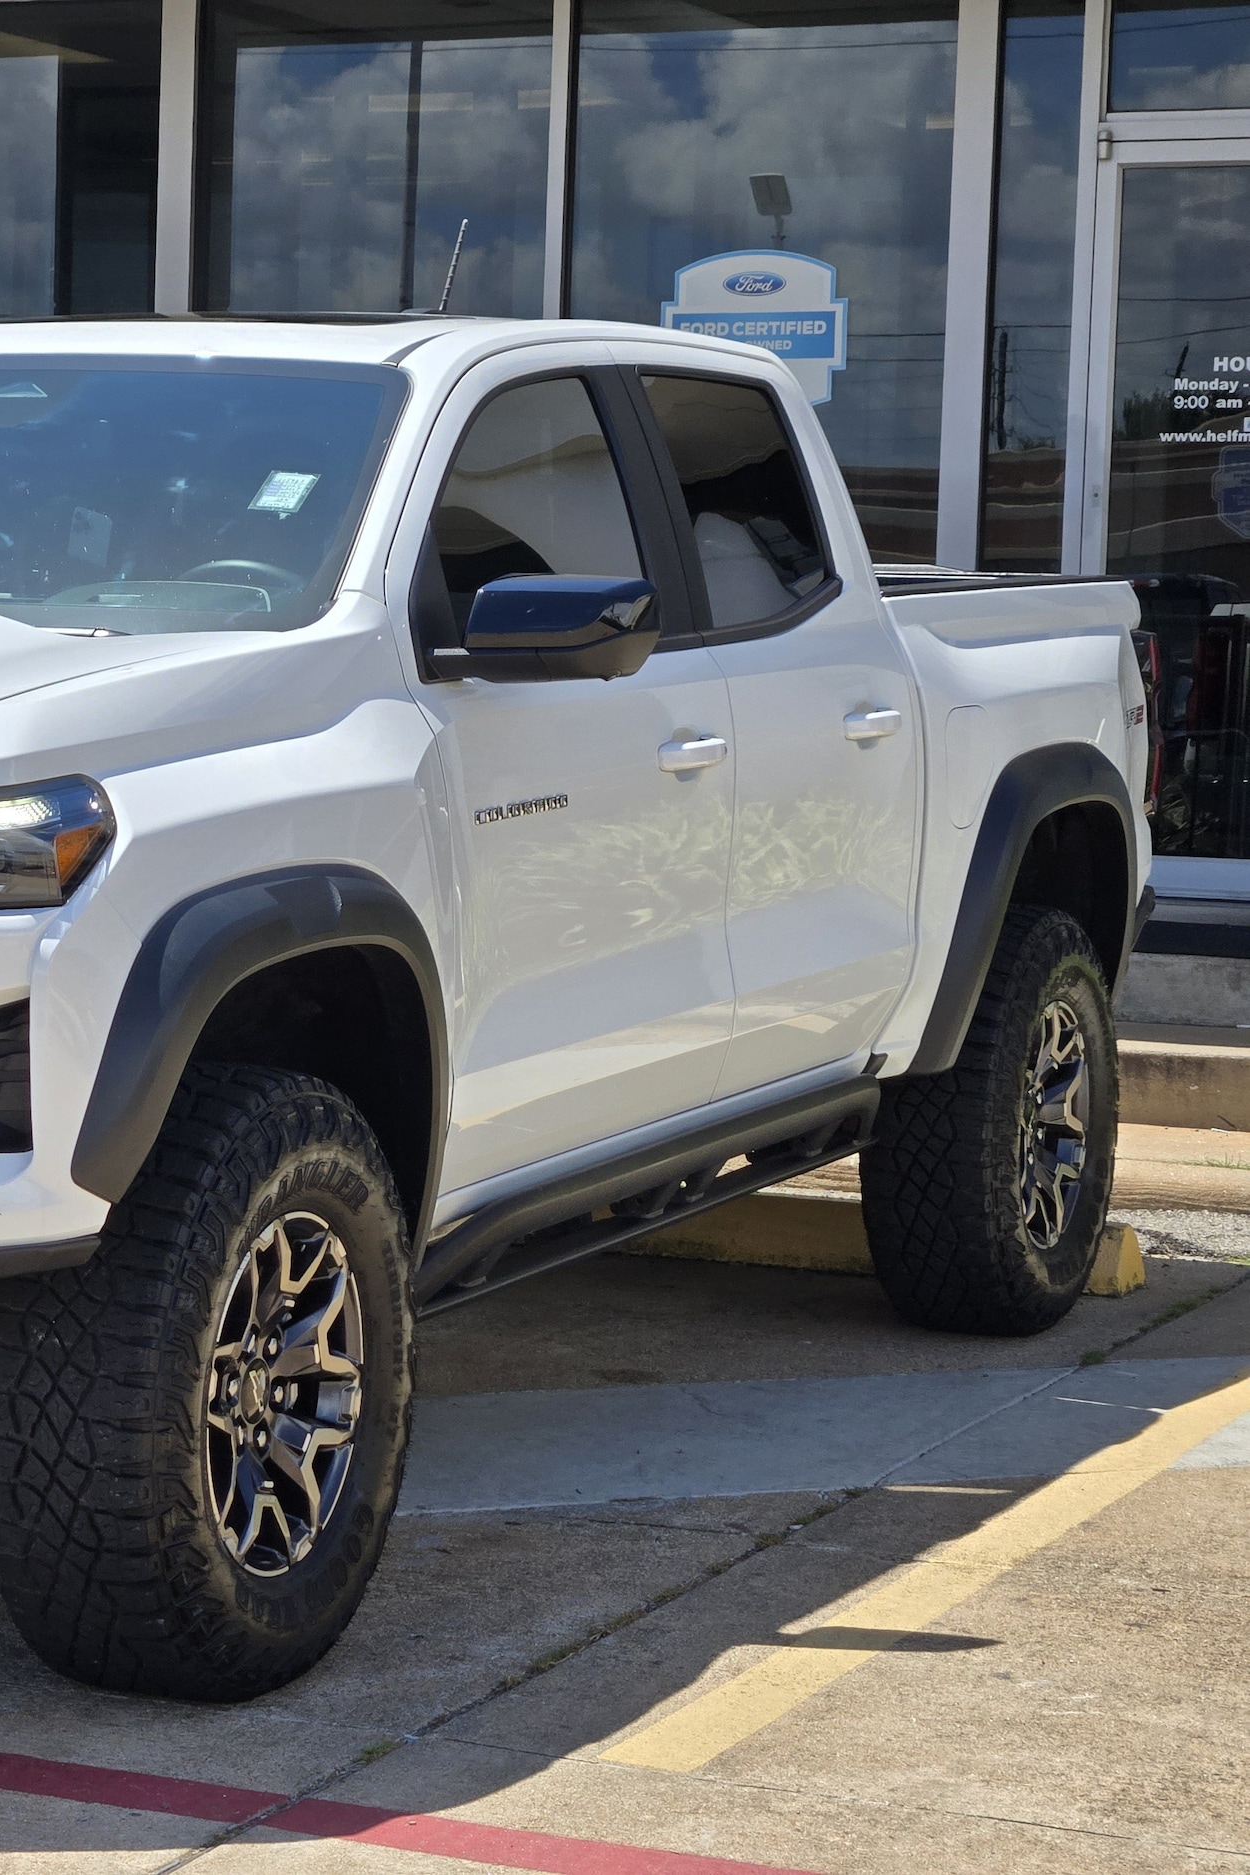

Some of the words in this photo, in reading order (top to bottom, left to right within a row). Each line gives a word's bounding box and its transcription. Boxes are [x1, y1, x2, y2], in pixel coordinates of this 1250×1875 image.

[734, 275, 773, 292] Ford
[680, 321, 729, 336] FORD
[732, 320, 827, 336] CERTIFIED
[1213, 356, 1250, 372] HO
[1174, 378, 1239, 393] Monday
[1173, 395, 1209, 409] 9:00
[1215, 398, 1243, 409] am
